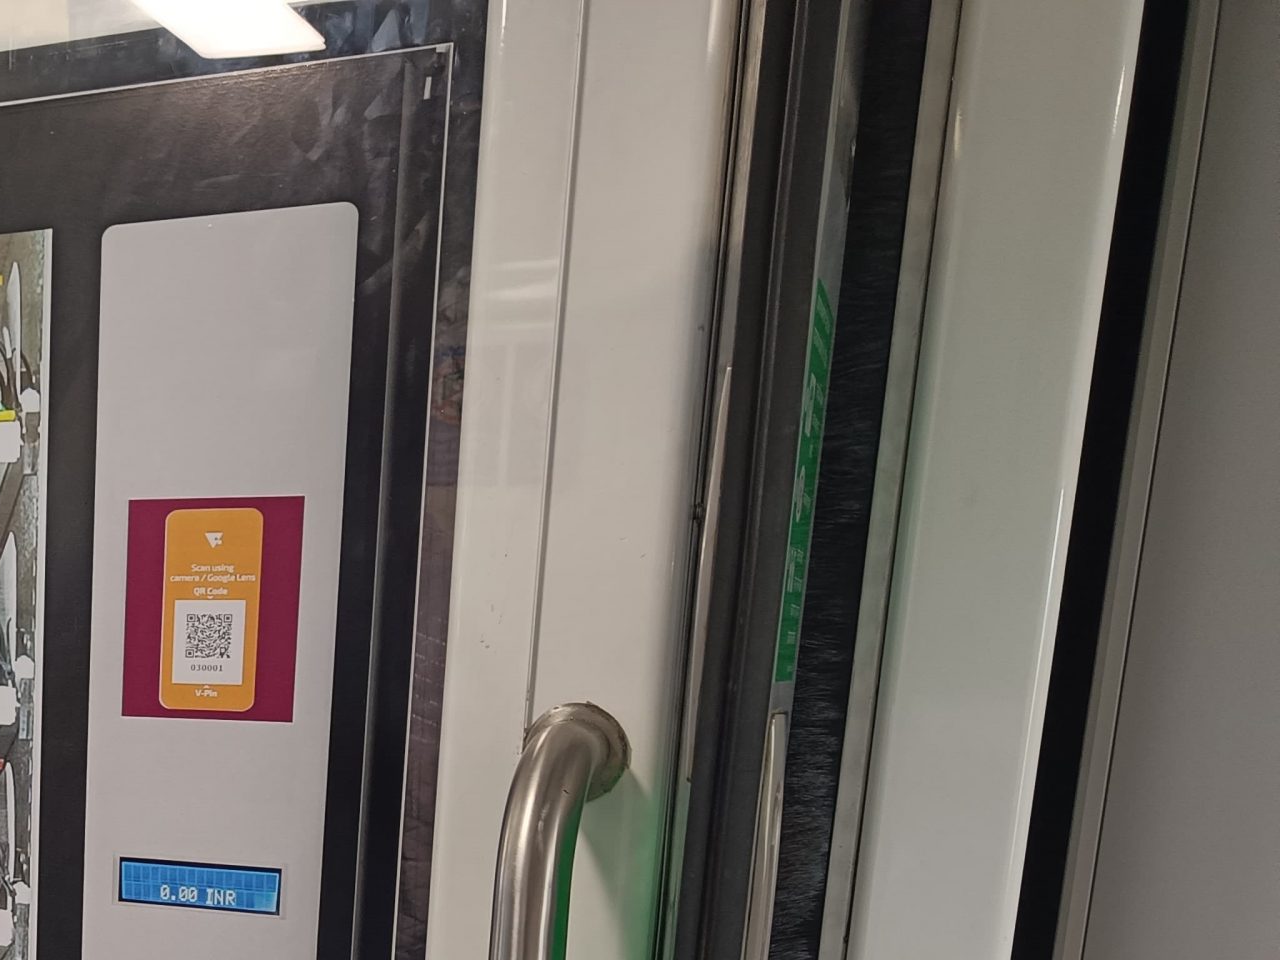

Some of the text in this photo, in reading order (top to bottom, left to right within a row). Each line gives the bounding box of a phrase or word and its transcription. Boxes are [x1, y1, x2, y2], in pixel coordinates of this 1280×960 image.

[191, 563, 234, 574] Scan using
[170, 574, 200, 582] camera
[207, 573, 235, 583] Google
[236, 574, 256, 582] Lens
[193, 587, 228, 596] QR Code
[190, 664, 223, 672] 030001
[160, 884, 236, 905] 0.00 INR
